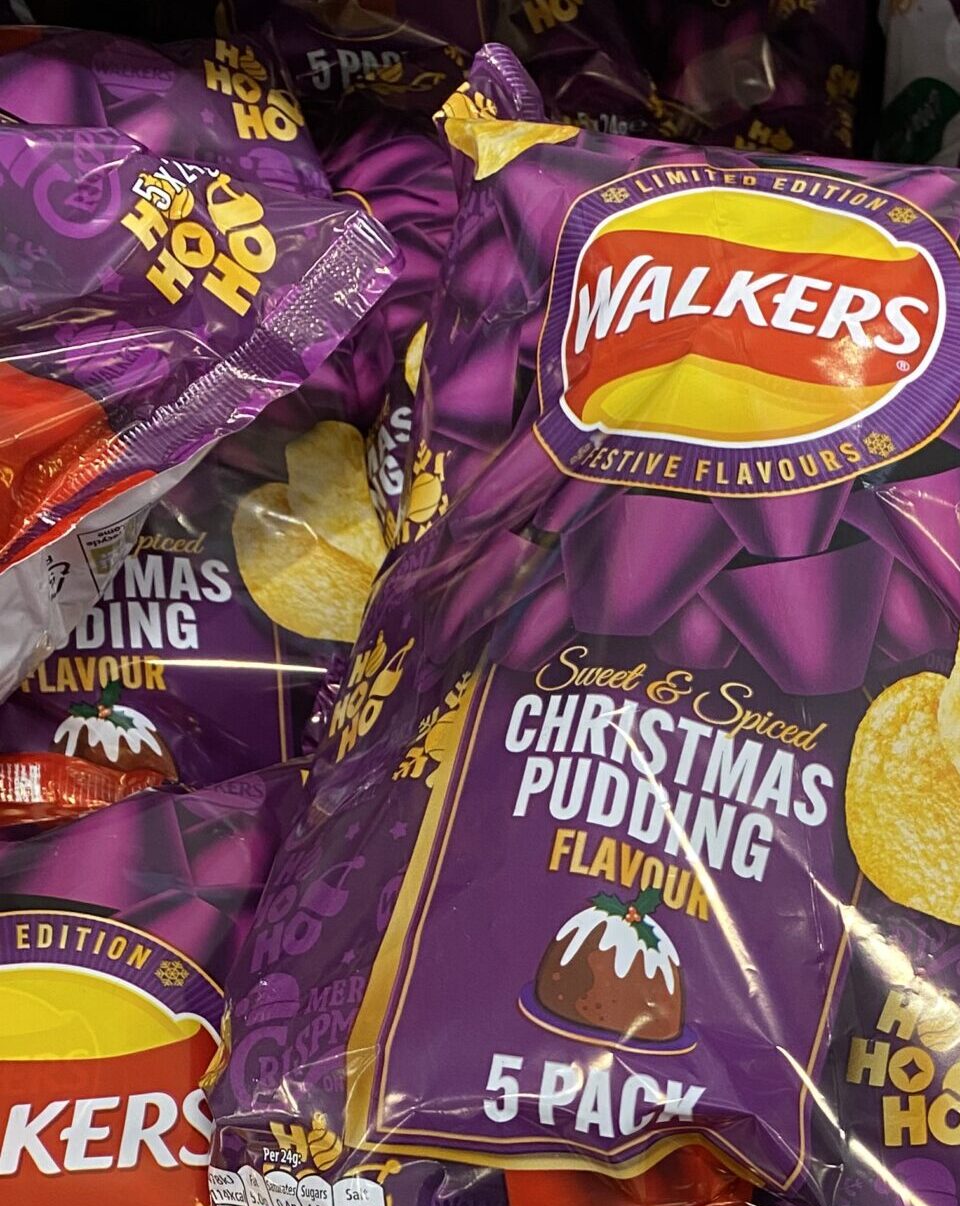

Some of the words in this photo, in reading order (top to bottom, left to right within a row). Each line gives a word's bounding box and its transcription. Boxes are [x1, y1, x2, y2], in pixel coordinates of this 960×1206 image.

[636, 168, 757, 195] LIMITED
[773, 177, 887, 211] EDITION
[147, 221, 215, 304] HO
[203, 225, 276, 317] HO
[574, 254, 930, 357] WALKERS
[584, 444, 680, 479] FESTIVE
[695, 441, 861, 485] FLAVOURS
[134, 531, 207, 557] piced
[535, 645, 647, 692] Sweet
[646, 670, 694, 705] &
[693, 682, 827, 752] Spiced
[504, 693, 834, 827] CHRISTMAS
[512, 756, 774, 882] PUDDING
[548, 828, 711, 922] FLAVOUR
[16, 922, 152, 971] EDITION
[483, 1053, 524, 1123] 5
[538, 1059, 707, 1138] PACK
[846, 1037, 936, 1093] HO
[263, 1147, 280, 1162] Per
[281, 1151, 302, 1166] 24g:
[300, 1184, 328, 1202] Sugars
